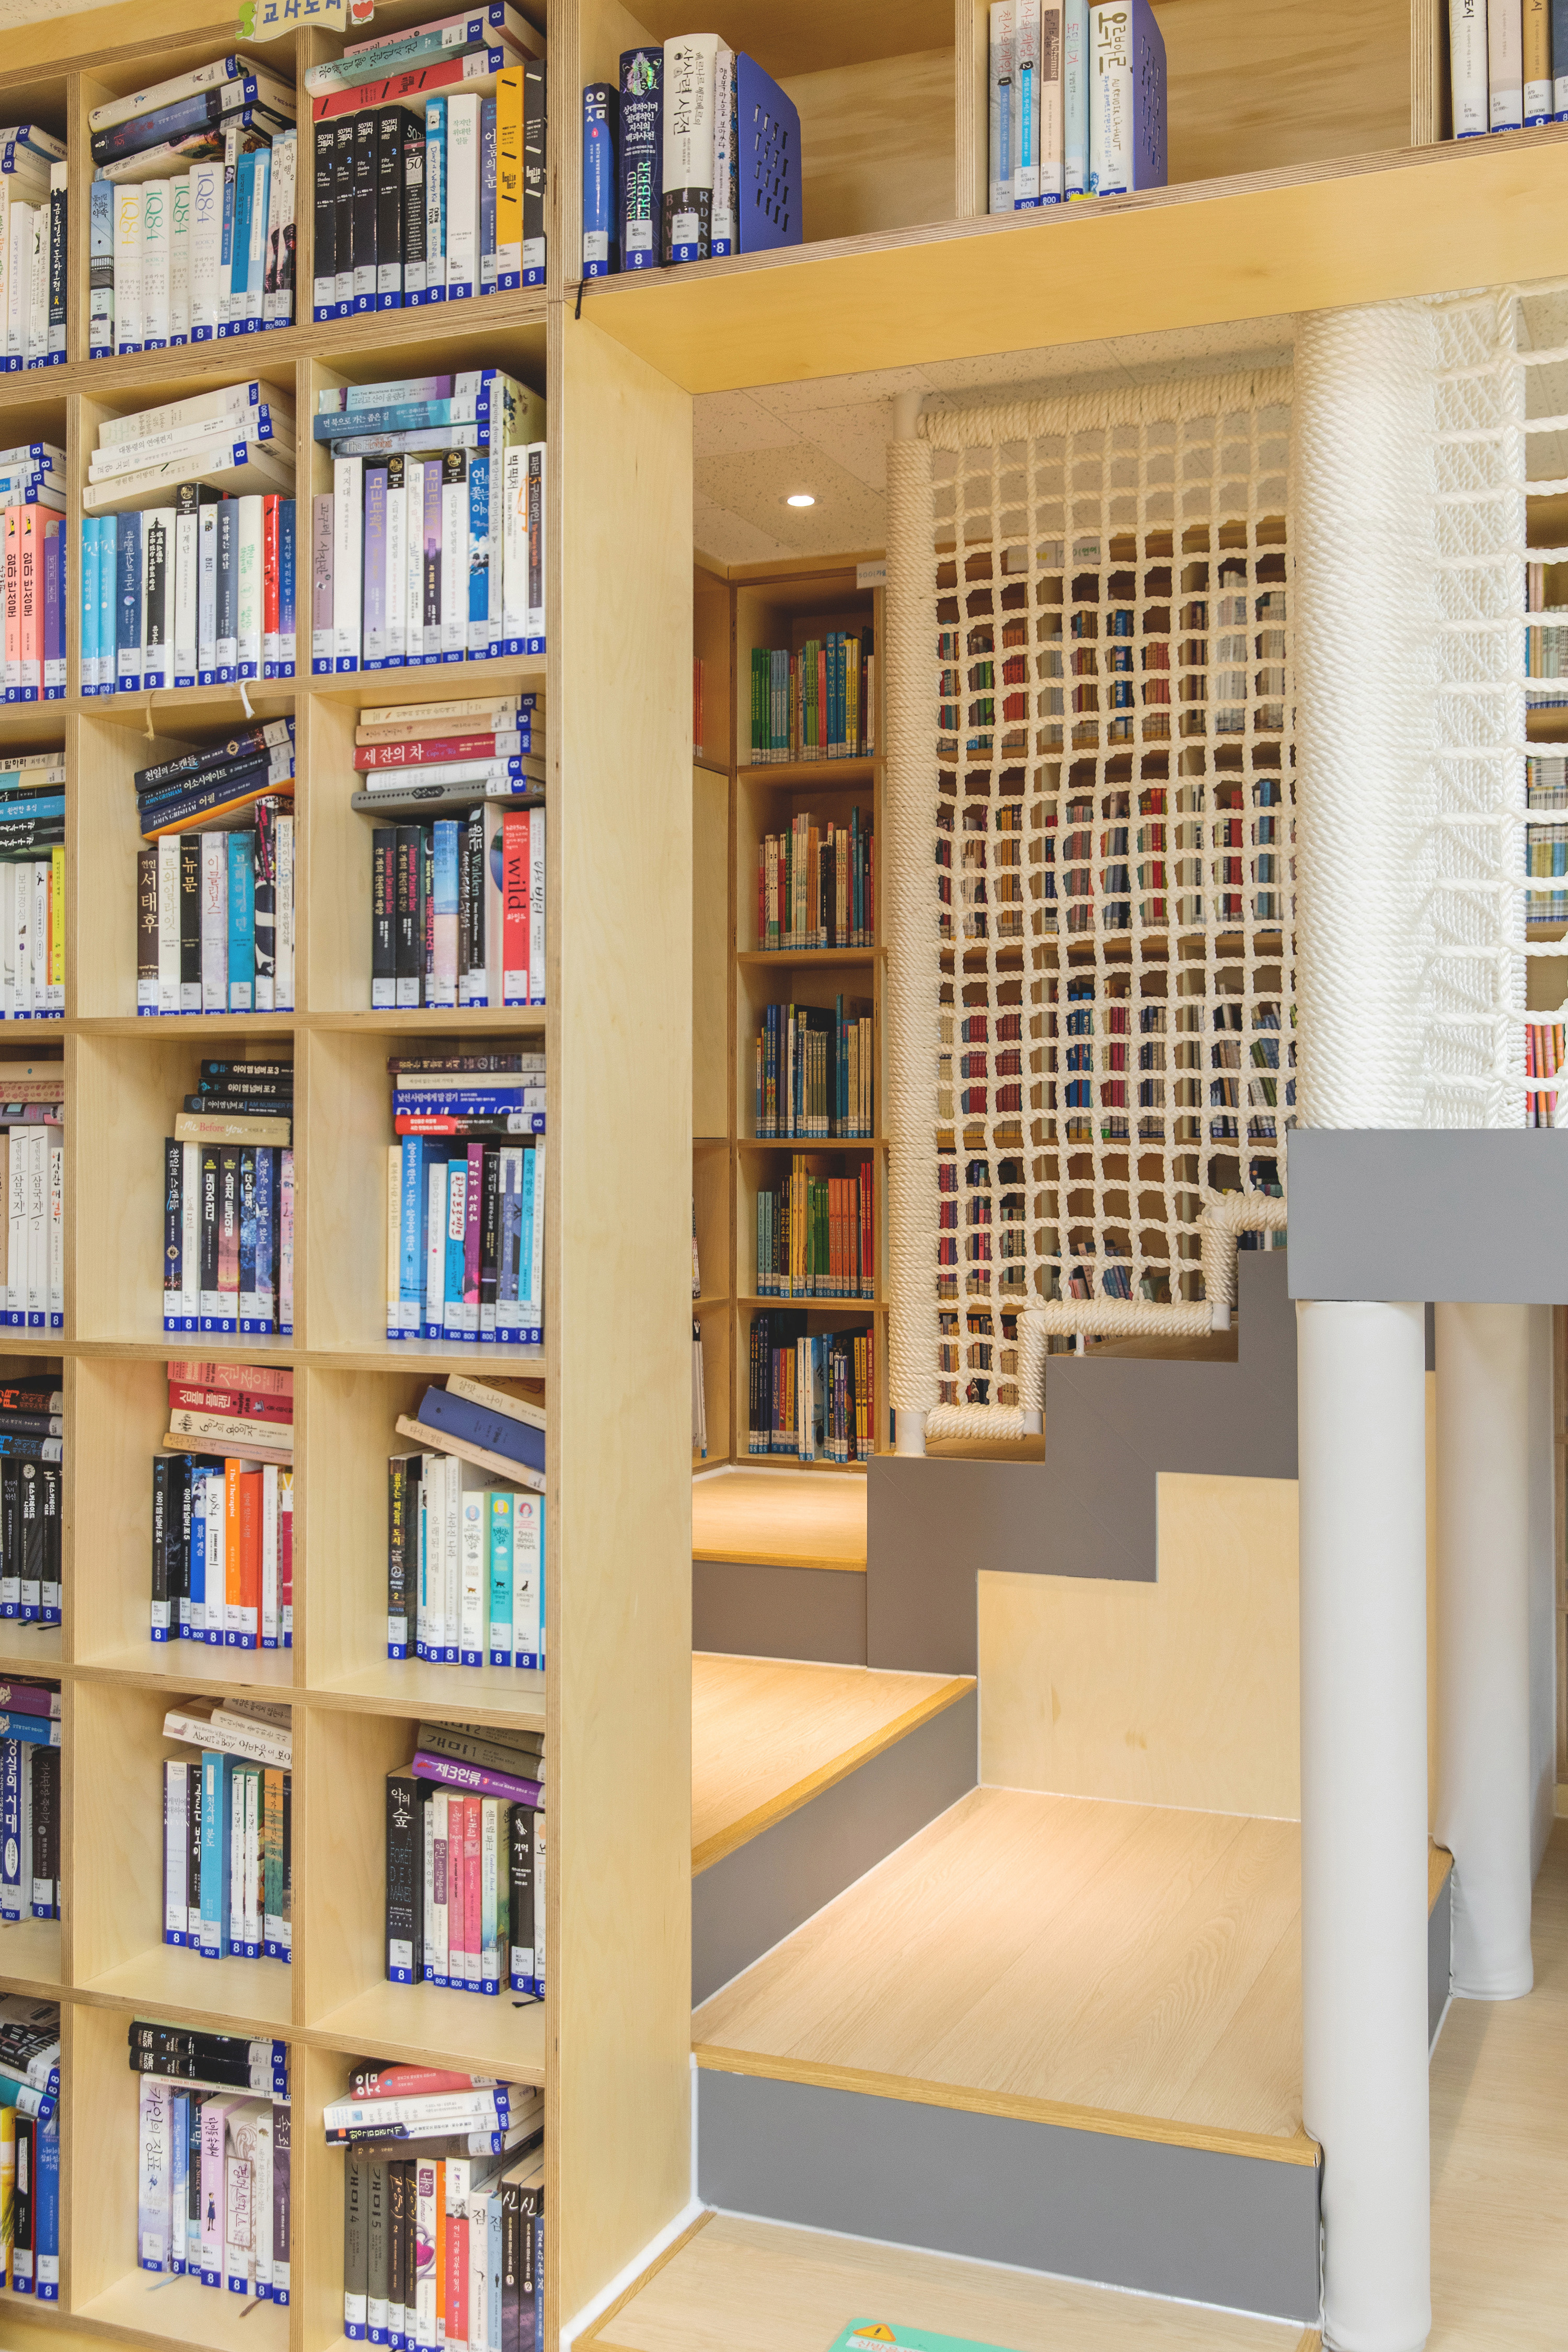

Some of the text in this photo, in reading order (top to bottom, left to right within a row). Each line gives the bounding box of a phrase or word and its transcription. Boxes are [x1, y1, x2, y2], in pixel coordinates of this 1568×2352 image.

[490, 54, 500, 63] 8
[1051, 36, 1059, 78] Alchemist
[246, 83, 255, 94] 8
[623, 102, 658, 115] 상대적이며
[626, 112, 654, 123] 절대적인
[629, 122, 650, 132] 지식의
[626, 131, 654, 142] 백과사전
[195, 169, 215, 224] 1Q84
[120, 194, 141, 245] 1Q84
[145, 189, 165, 241] 1Q84
[635, 253, 642, 264] 8
[528, 271, 536, 282] 8
[431, 289, 438, 299] 8
[340, 304, 348, 314] 8
[196, 328, 204, 339] 8
[260, 424, 270, 433] 8
[491, 644, 498, 655] 8
[531, 640, 538, 651] 8
[150, 675, 156, 686] 8
[25, 688, 31, 699] 8
[363, 744, 424, 765] 세 잔의 차
[508, 857, 526, 910] wild
[141, 871, 158, 933] 서태후
[34, 1221, 40, 1230] 2
[53, 1316, 59, 1325] 8
[223, 1320, 229, 1331] 8
[260, 1321, 266, 1332] 8
[501, 1330, 508, 1341] 8
[209, 1493, 220, 1516] 1984
[26, 1608, 31, 1617] 8
[155, 1629, 161, 1639] 8
[229, 1633, 235, 1642] 8
[393, 1647, 399, 1657] 8
[468, 1653, 475, 1663] 8
[523, 1655, 529, 1666] 8
[193, 1732, 215, 1743] About
[221, 1738, 235, 1749] Boy
[436, 1762, 482, 1785] 제3인류
[5, 1795, 18, 1835] 시대
[393, 1807, 416, 1828] 숲
[514, 1843, 528, 1852] 기억
[174, 1933, 180, 1943] 8
[270, 1944, 276, 1954] 8
[398, 1970, 405, 1980] 8
[517, 1978, 524, 1988] 8
[174, 2262, 179, 2271] 8
[234, 2280, 240, 2289] 8
[45, 2285, 52, 2296] 8
[372, 2330, 379, 2341] 8
